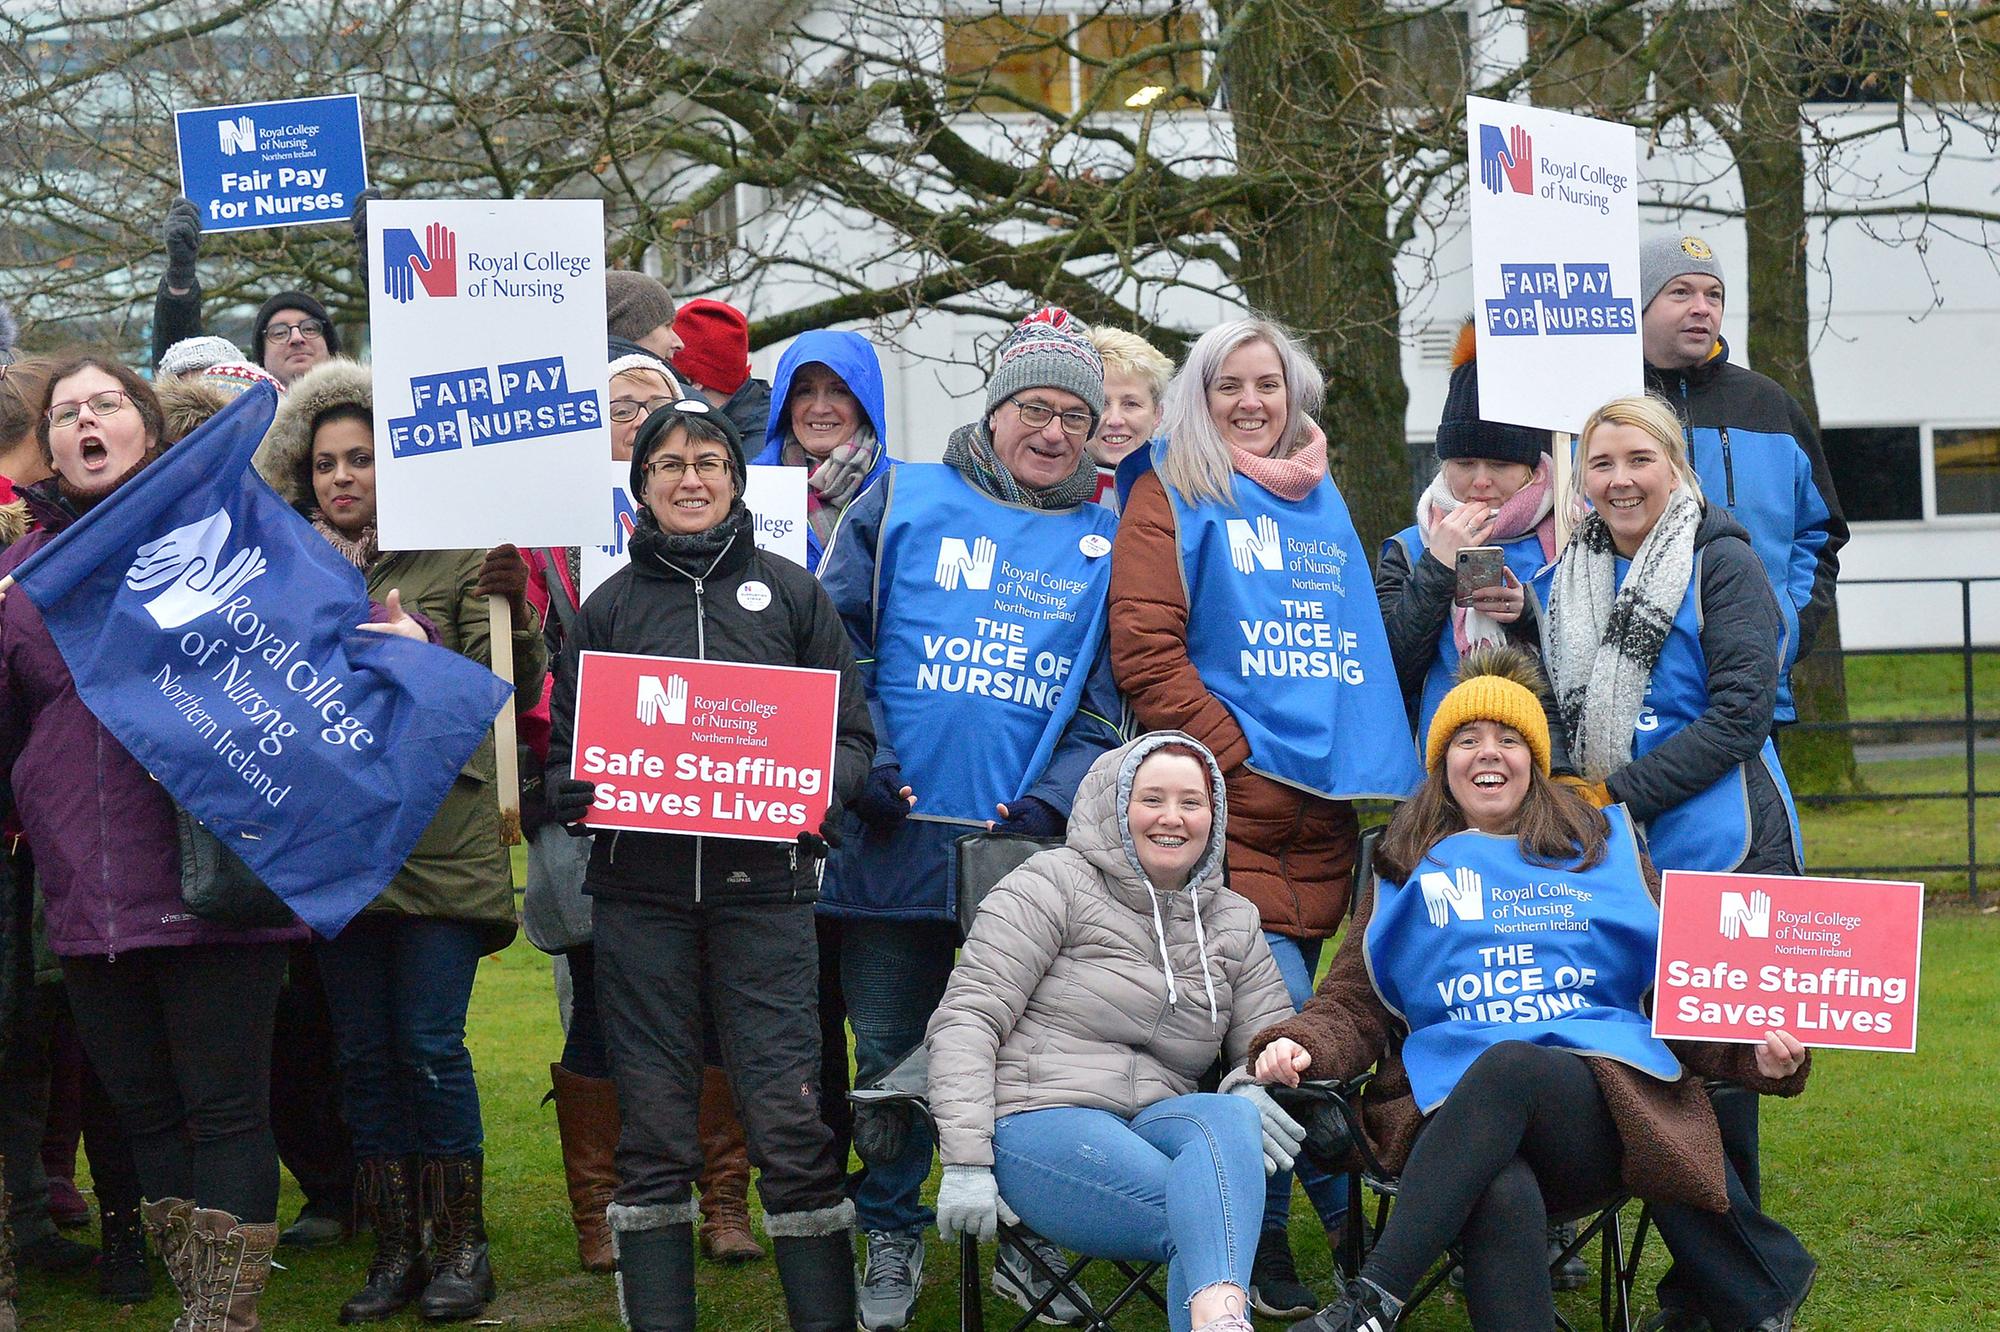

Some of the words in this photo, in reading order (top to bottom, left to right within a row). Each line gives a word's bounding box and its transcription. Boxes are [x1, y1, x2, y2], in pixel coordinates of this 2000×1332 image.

[260, 127, 284, 139] Royal
[286, 124, 319, 137] College
[261, 141, 271, 150] of
[272, 138, 308, 149] Nursing
[262, 153, 292, 161] Northern
[294, 149, 316, 159] Ireland
[221, 170, 272, 193] Fair
[278, 168, 327, 188] Pay
[1541, 157, 1576, 183] Royal
[1581, 164, 1627, 194] College
[210, 199, 248, 219] for
[255, 192, 344, 215] Nurses
[1541, 182, 1556, 199] of
[1559, 185, 1610, 215] Nursing
[468, 252, 517, 277] Royal
[524, 251, 590, 277] College
[468, 278, 488, 297] of
[493, 279, 564, 303] Nursing
[1503, 272, 1557, 294] FAIR
[1565, 272, 1608, 294] PAY
[1488, 307, 1536, 330] FOR
[1544, 306, 1634, 329] NURSES
[413, 377, 489, 409] FAIR
[501, 366, 562, 397] PAY
[391, 420, 458, 451] FOR
[471, 400, 598, 440] NURSES
[755, 513, 793, 538] llege
[1287, 538, 1317, 558] Royal
[1320, 541, 1347, 565] College
[1001, 560, 1039, 583] Royal
[1041, 572, 1088, 594] College
[1290, 557, 1302, 571] of
[1305, 559, 1341, 582] Nursing
[997, 582, 1013, 595] of
[1015, 585, 1067, 610] Nursing
[1292, 578, 1331, 592] Northern
[994, 599, 1040, 619] Northern
[1043, 610, 1076, 623] Ireland
[1280, 599, 1324, 620] THE
[216, 595, 301, 671] Royal
[975, 617, 1025, 644] THE
[1239, 620, 1333, 648] VOICE
[180, 631, 228, 667] of
[923, 635, 1029, 671] VOICE
[1035, 651, 1072, 681] OF
[1240, 649, 1365, 686] NURSIG
[917, 663, 1064, 712] NURSING
[694, 696, 728, 713] Royal
[732, 699, 778, 719] College
[152, 663, 218, 740] Northern
[213, 729, 292, 808] Ireland
[692, 715, 706, 727] of
[709, 715, 758, 734] Nursing
[691, 731, 734, 744] Northern
[736, 735, 768, 747] Ireland
[583, 745, 664, 778] Safe
[674, 752, 822, 795] Staffing
[593, 782, 702, 818] Saves
[711, 791, 807, 825] Lives
[1491, 883, 1534, 906] Royal
[1537, 882, 1592, 902] College
[1492, 905, 1510, 919] of
[1513, 902, 1574, 918] Nursing
[1777, 910, 1811, 927] Royal
[1814, 912, 1861, 930] College
[1494, 921, 1548, 934] Northern
[1550, 918, 1589, 932] Ireland
[1775, 926, 1790, 939] of
[1792, 926, 1841, 946] Nursing
[1478, 943, 1535, 968] THE
[1775, 944, 1817, 956] Northern
[1820, 947, 1851, 958] Ireland
[1437, 967, 1545, 1007] VOICE
[1554, 965, 1597, 990] OF
[1666, 960, 1748, 990] Safe
[1758, 964, 1907, 1004] Staffing
[1677, 995, 1785, 1027] Saves
[1797, 1002, 1892, 1034] Lives
